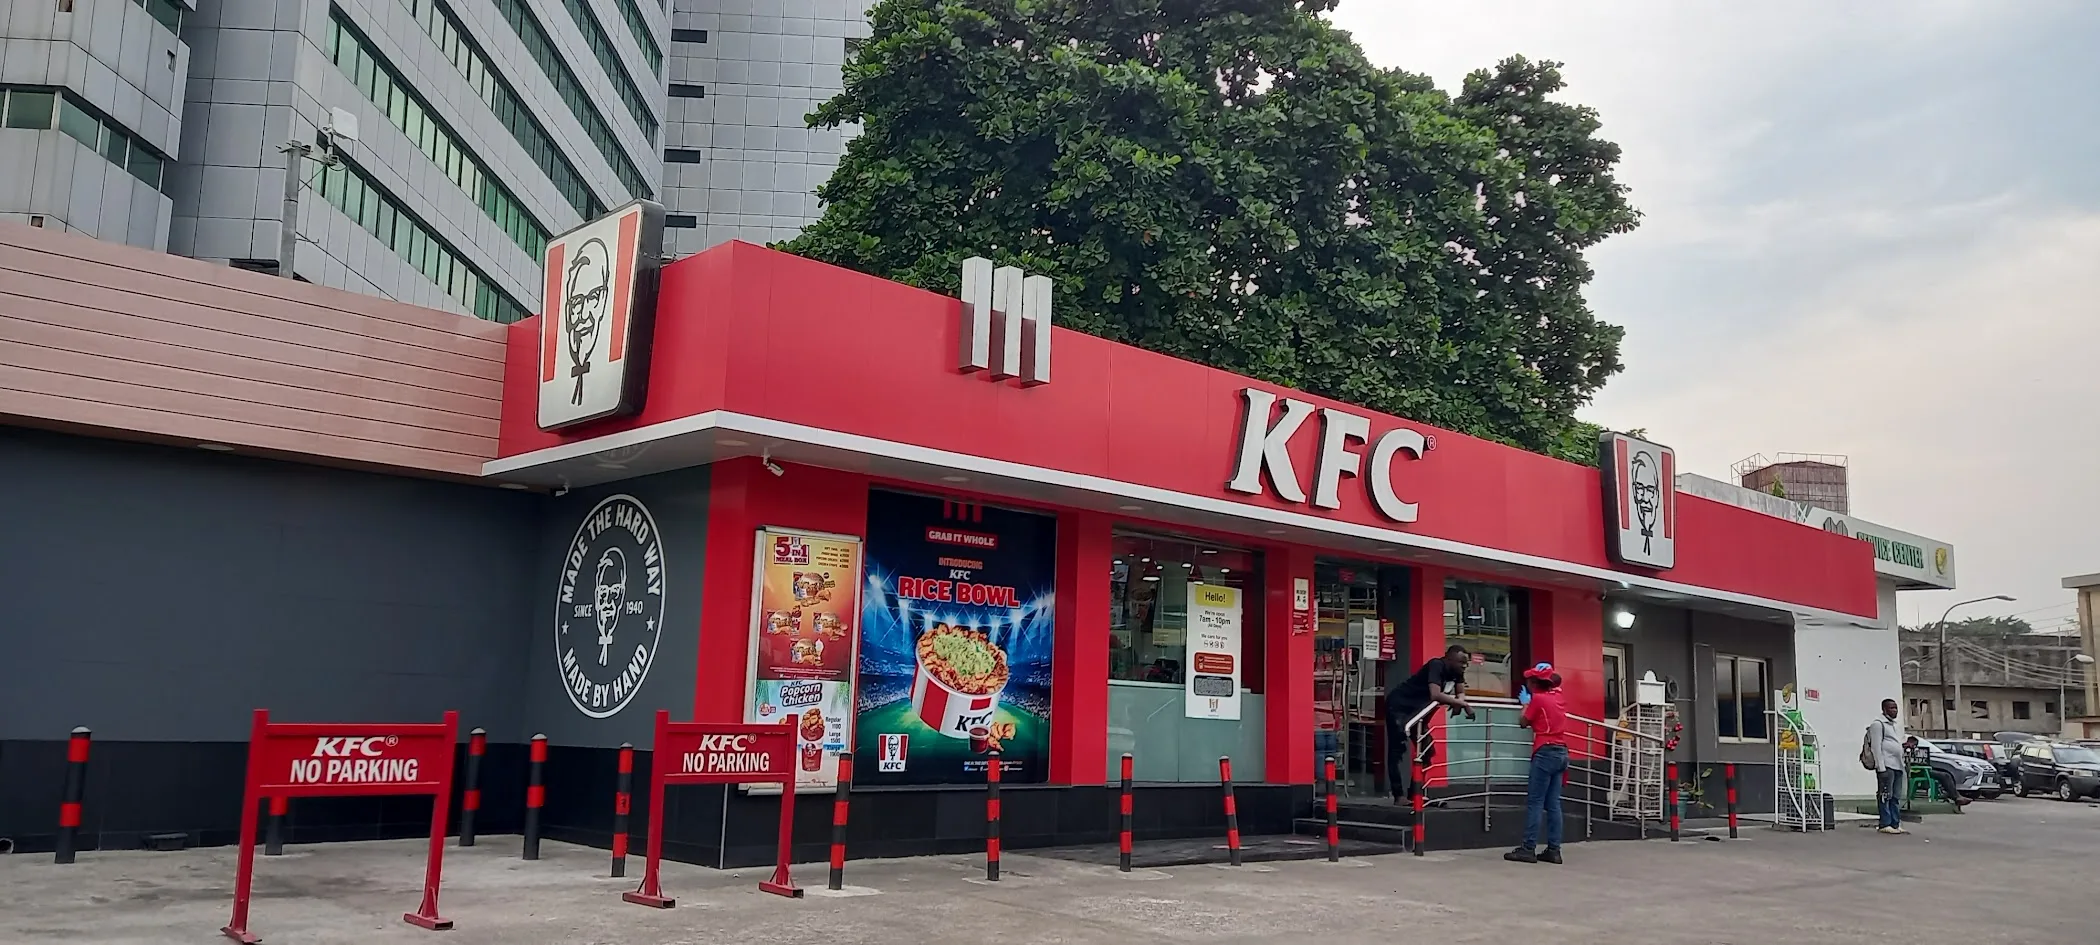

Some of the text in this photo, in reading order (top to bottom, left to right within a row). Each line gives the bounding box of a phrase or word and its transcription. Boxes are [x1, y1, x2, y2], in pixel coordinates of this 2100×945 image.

[776, 537, 790, 556] 5
[928, 531, 995, 546] GRAB IT WHOLE
[562, 504, 661, 604] MADE THE HARD WAY
[1892, 541, 1924, 569] CENTER
[938, 557, 983, 570] INTRODUCING
[949, 569, 971, 580] KFC
[898, 576, 1021, 608] RICE BOWL
[1204, 591, 1226, 603] Hello!
[573, 601, 644, 618] SINCE 1940
[1215, 616, 1231, 625] 10pm
[563, 643, 648, 708] MADE BY HAND
[781, 683, 821, 697] Popcorn
[783, 693, 821, 706] Chicken
[682, 752, 769, 772] NO PARKING
[882, 761, 902, 770] KFC
[289, 758, 418, 783] NO PARKING
